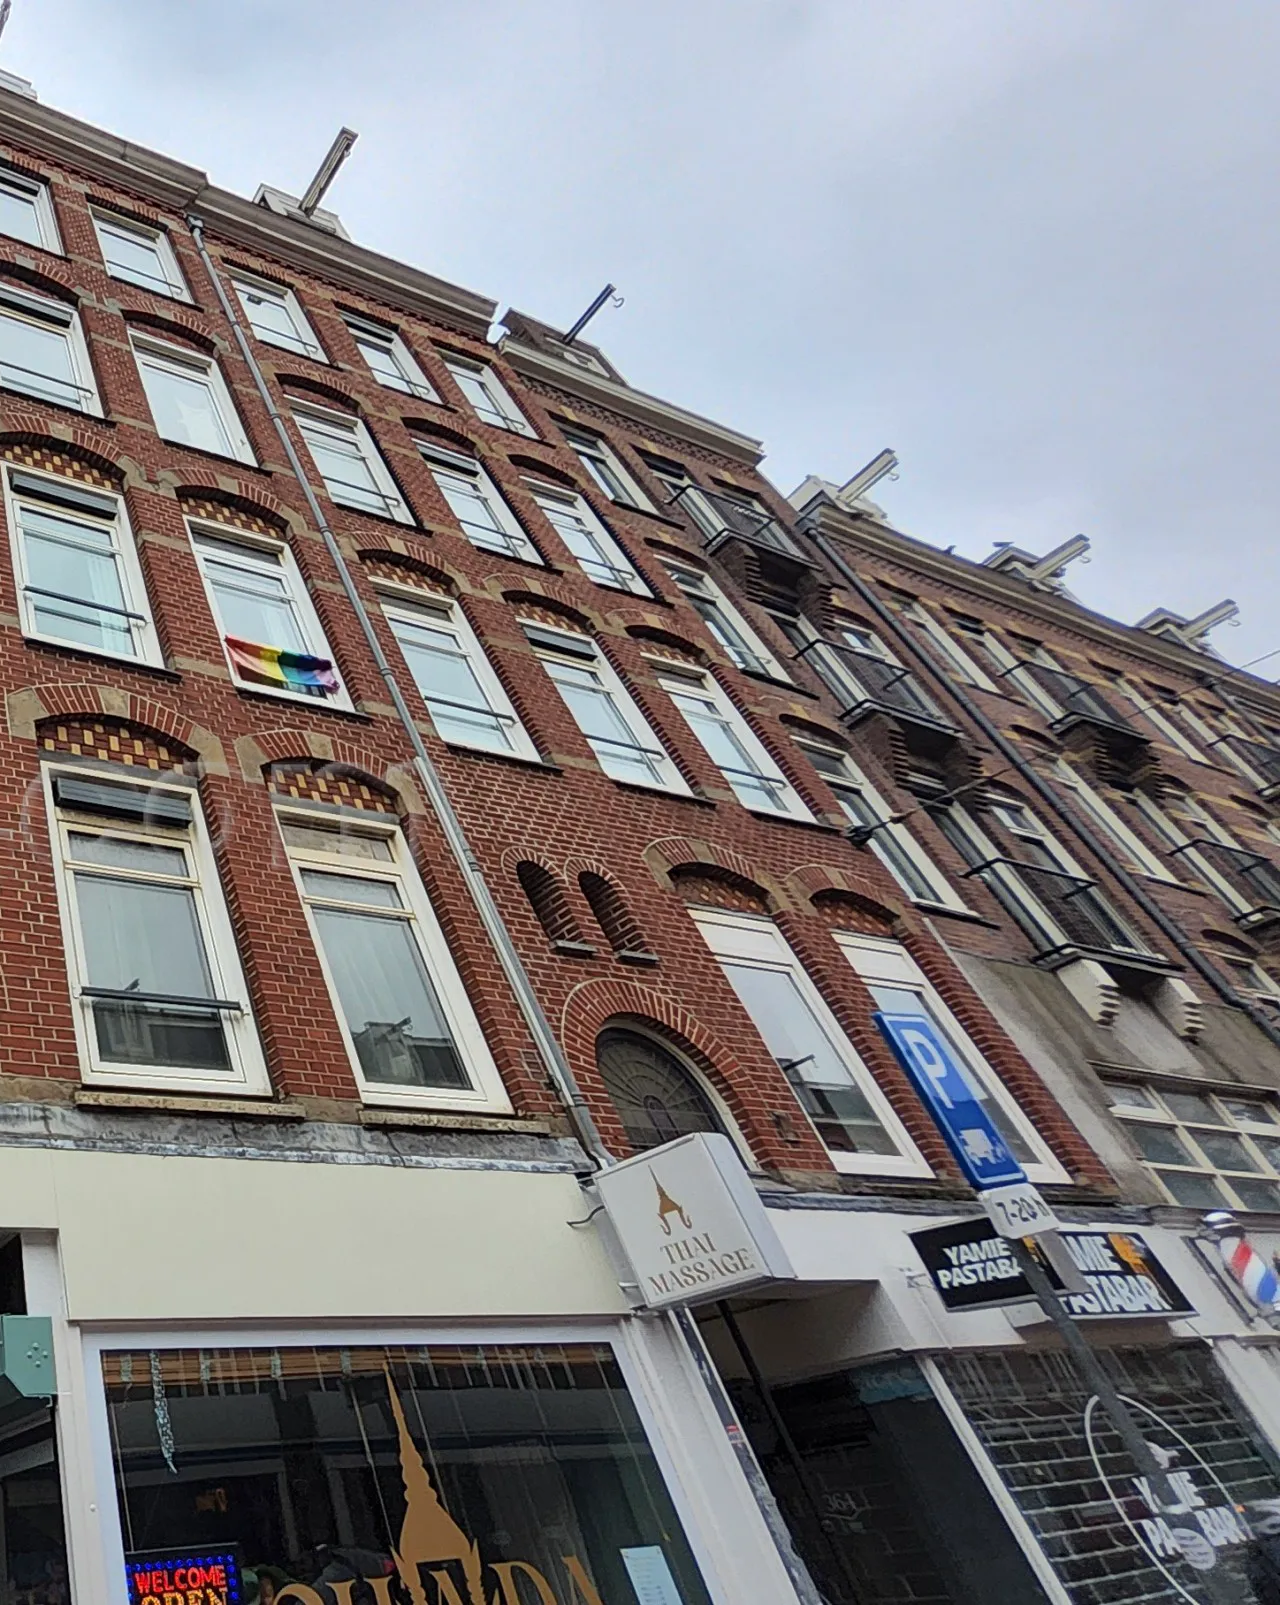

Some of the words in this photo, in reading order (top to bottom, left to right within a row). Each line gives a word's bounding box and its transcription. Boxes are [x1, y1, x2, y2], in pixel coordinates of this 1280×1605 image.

[900, 1029, 955, 1109] P
[995, 1197, 1038, 1227] 7-20
[660, 1233, 718, 1265] THAI
[942, 1237, 1011, 1266] YAMIE
[648, 1248, 756, 1296] MASSAGE
[135, 1564, 227, 1594] WELCOME
